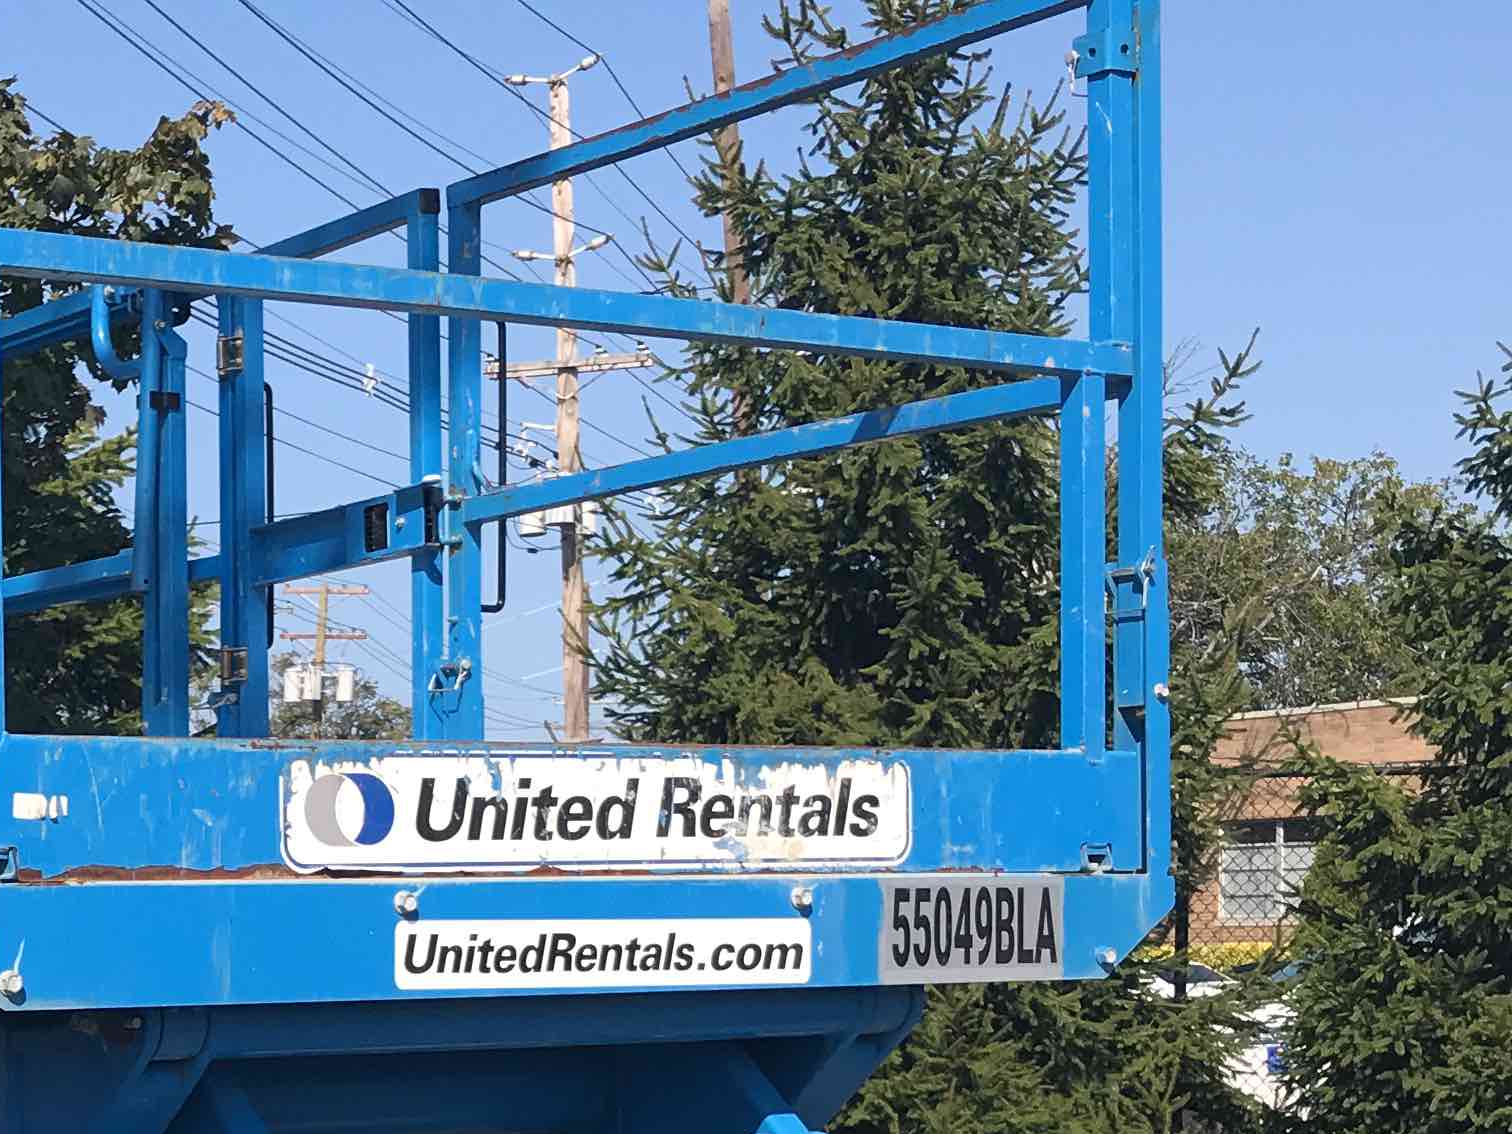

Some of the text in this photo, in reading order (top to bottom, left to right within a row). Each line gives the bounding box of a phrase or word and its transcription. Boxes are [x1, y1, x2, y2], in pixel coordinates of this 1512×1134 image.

[414, 775, 881, 842] United Rentals
[403, 931, 804, 975] UnitedRentals.com
[891, 885, 1058, 968] 55049BLA
